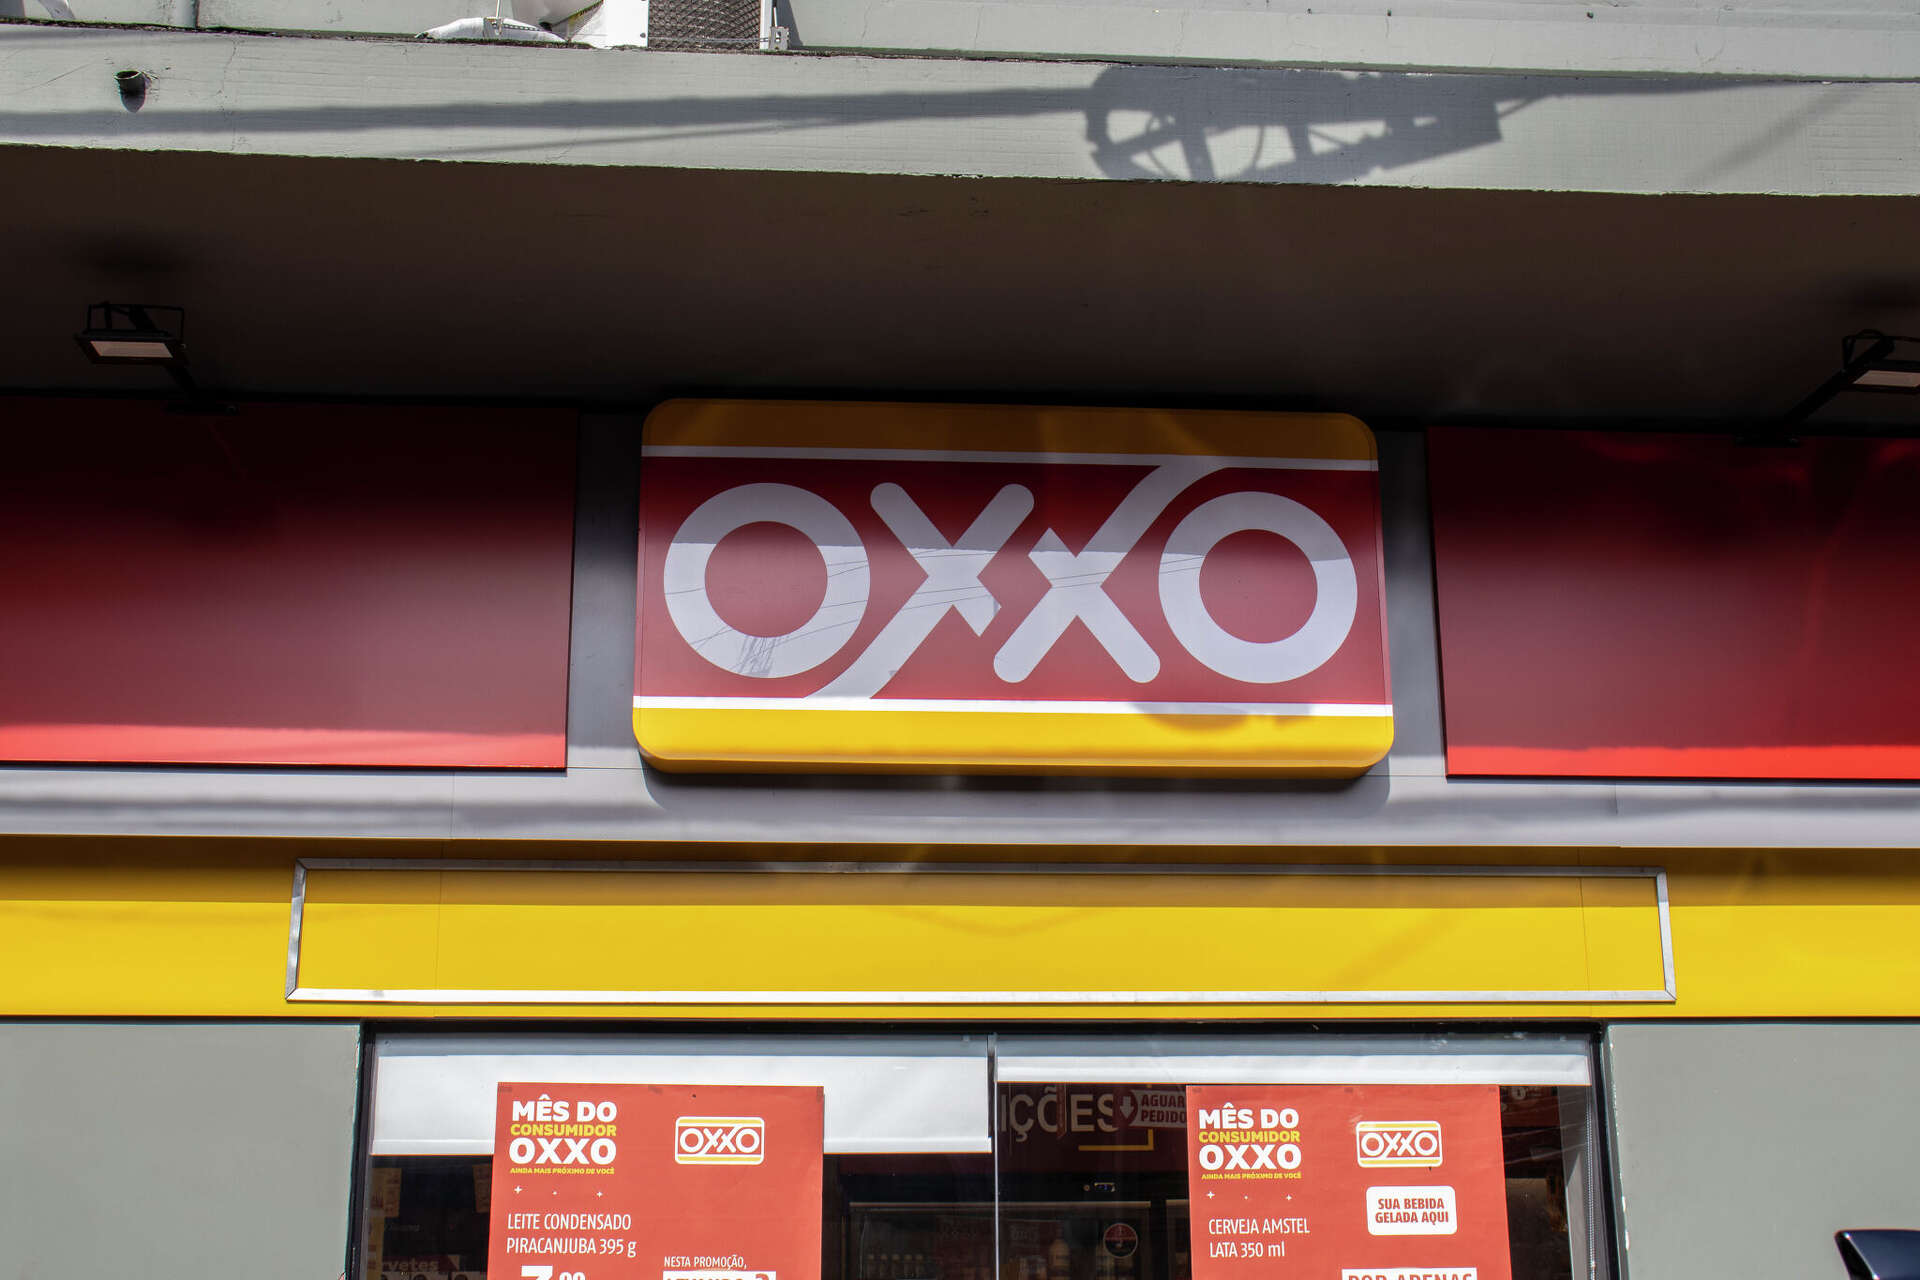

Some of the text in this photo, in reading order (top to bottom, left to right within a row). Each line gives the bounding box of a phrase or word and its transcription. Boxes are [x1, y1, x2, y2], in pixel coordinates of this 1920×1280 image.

[663, 468, 1358, 698] OXXO
[512, 1093, 617, 1122] MÊS DO
[1199, 1102, 1299, 1129] MÊS DO
[510, 1124, 617, 1136] CONSUMIDOR
[1199, 1131, 1301, 1143] CONSUMIDOR
[680, 1126, 760, 1154] OXXO
[1361, 1130, 1438, 1157] OXXO
[509, 1137, 617, 1165] OXXO
[1199, 1143, 1302, 1170] OXXO
[586, 1167, 595, 1175] DE
[596, 1167, 615, 1175] VOCÊ
[1284, 1171, 1302, 1179] VOCÊ
[1378, 1198, 1445, 1210] SUA BEBIDA
[507, 1213, 632, 1230] LEITE CONDENSADO
[1208, 1218, 1310, 1235] CERVEJA AMSTEL
[1375, 1211, 1449, 1225] GELADA AQUI
[506, 1237, 637, 1258] PIRACANJUBA 395 g
[1209, 1241, 1285, 1258] LATA 350 ml
[664, 1254, 747, 1270] NESTA PROMOÇÃO,
